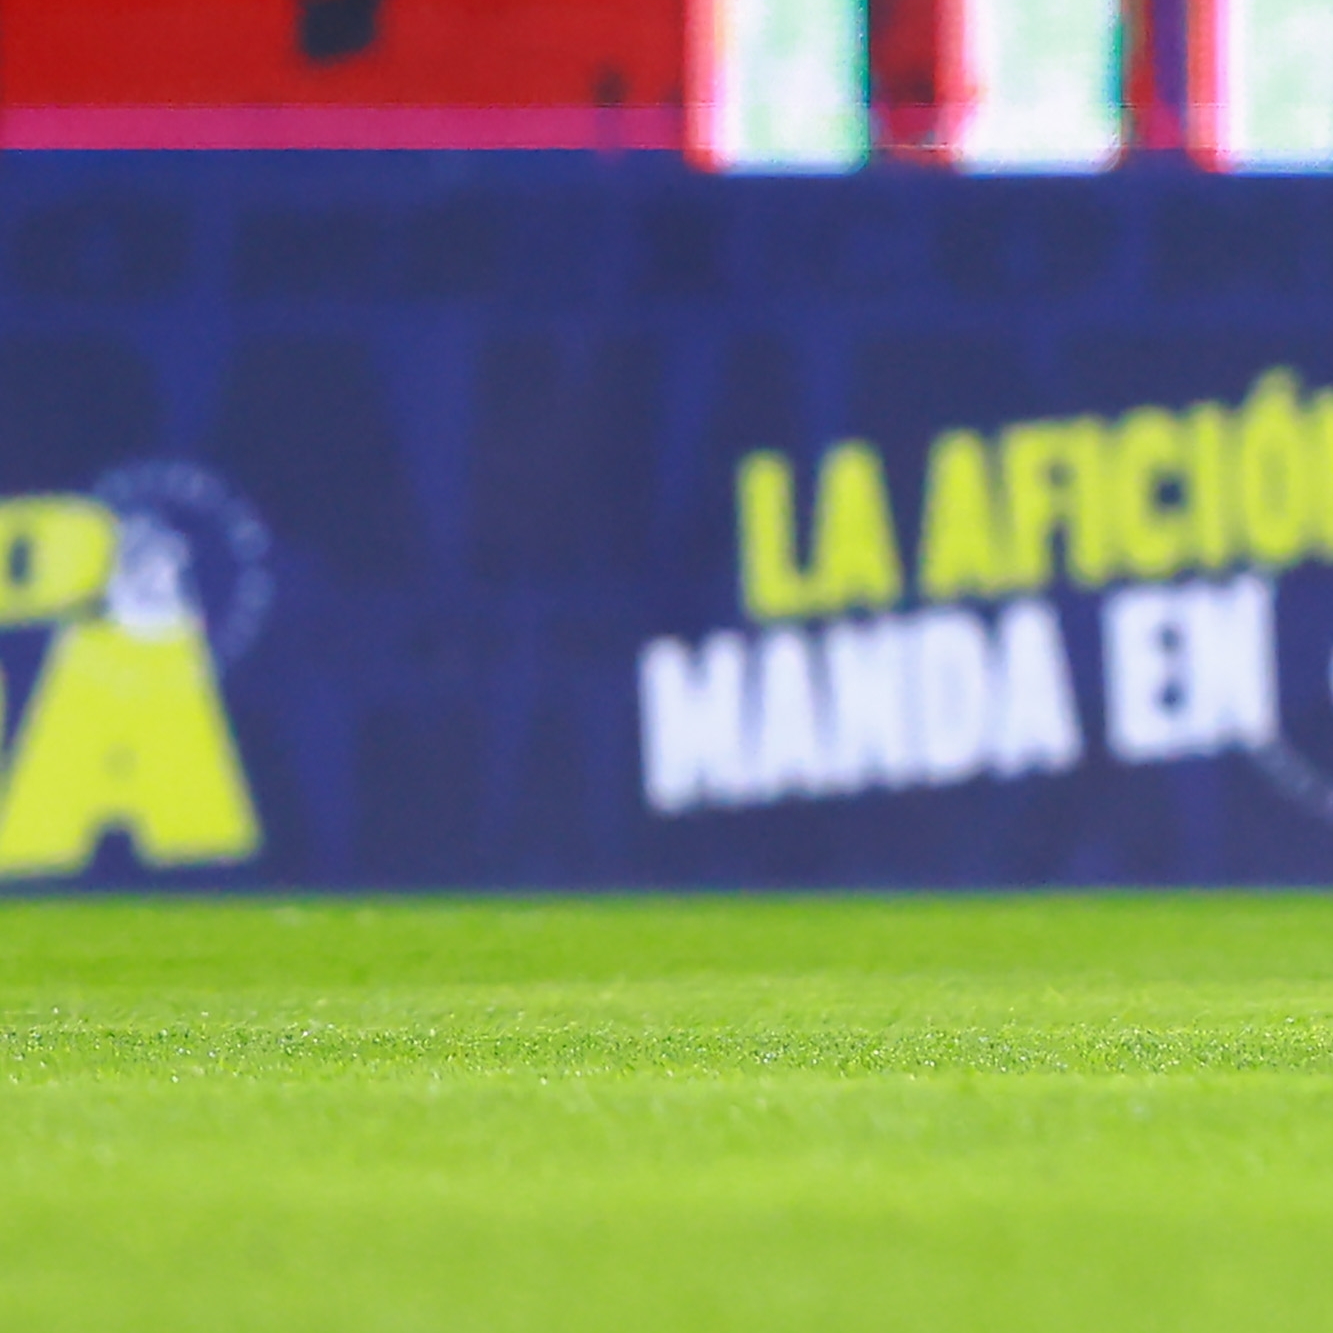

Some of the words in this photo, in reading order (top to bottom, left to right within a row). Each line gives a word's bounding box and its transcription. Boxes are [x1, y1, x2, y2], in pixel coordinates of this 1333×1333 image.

[738, 450, 898, 623] LA
[639, 599, 1082, 815] MANDA
[1102, 572, 1278, 765] EN
